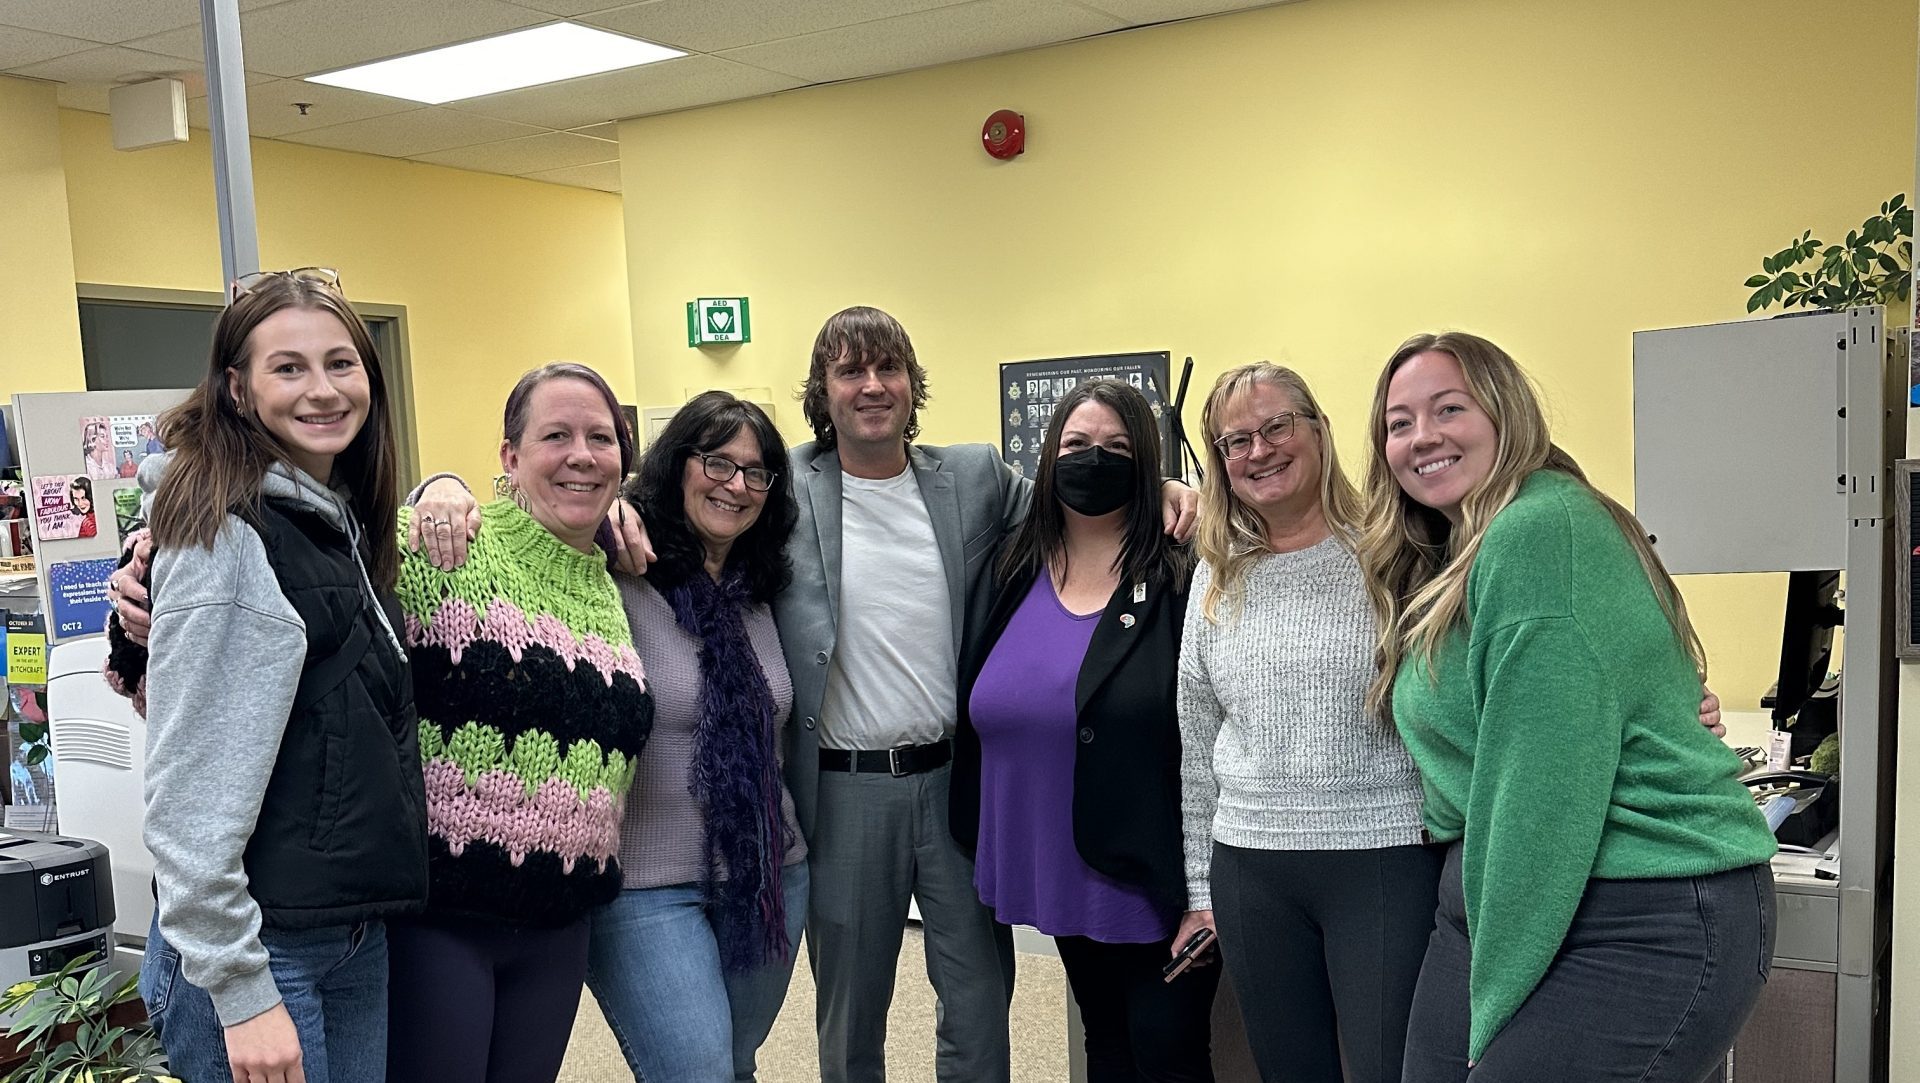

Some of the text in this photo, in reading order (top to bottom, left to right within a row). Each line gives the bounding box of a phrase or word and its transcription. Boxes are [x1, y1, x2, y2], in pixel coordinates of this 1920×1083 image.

[43, 487, 62, 495] ABOUT
[44, 497, 61, 505] HOW
[40, 513, 71, 524] YOU THINK
[62, 589, 97, 598] expressions
[69, 597, 82, 605] their
[83, 595, 102, 603] inside
[61, 621, 83, 631] OCT 2
[13, 646, 41, 656] EXPERT
[10, 665, 44, 673] BITCHCRAFT
[54, 868, 90, 881] ENTRUST
